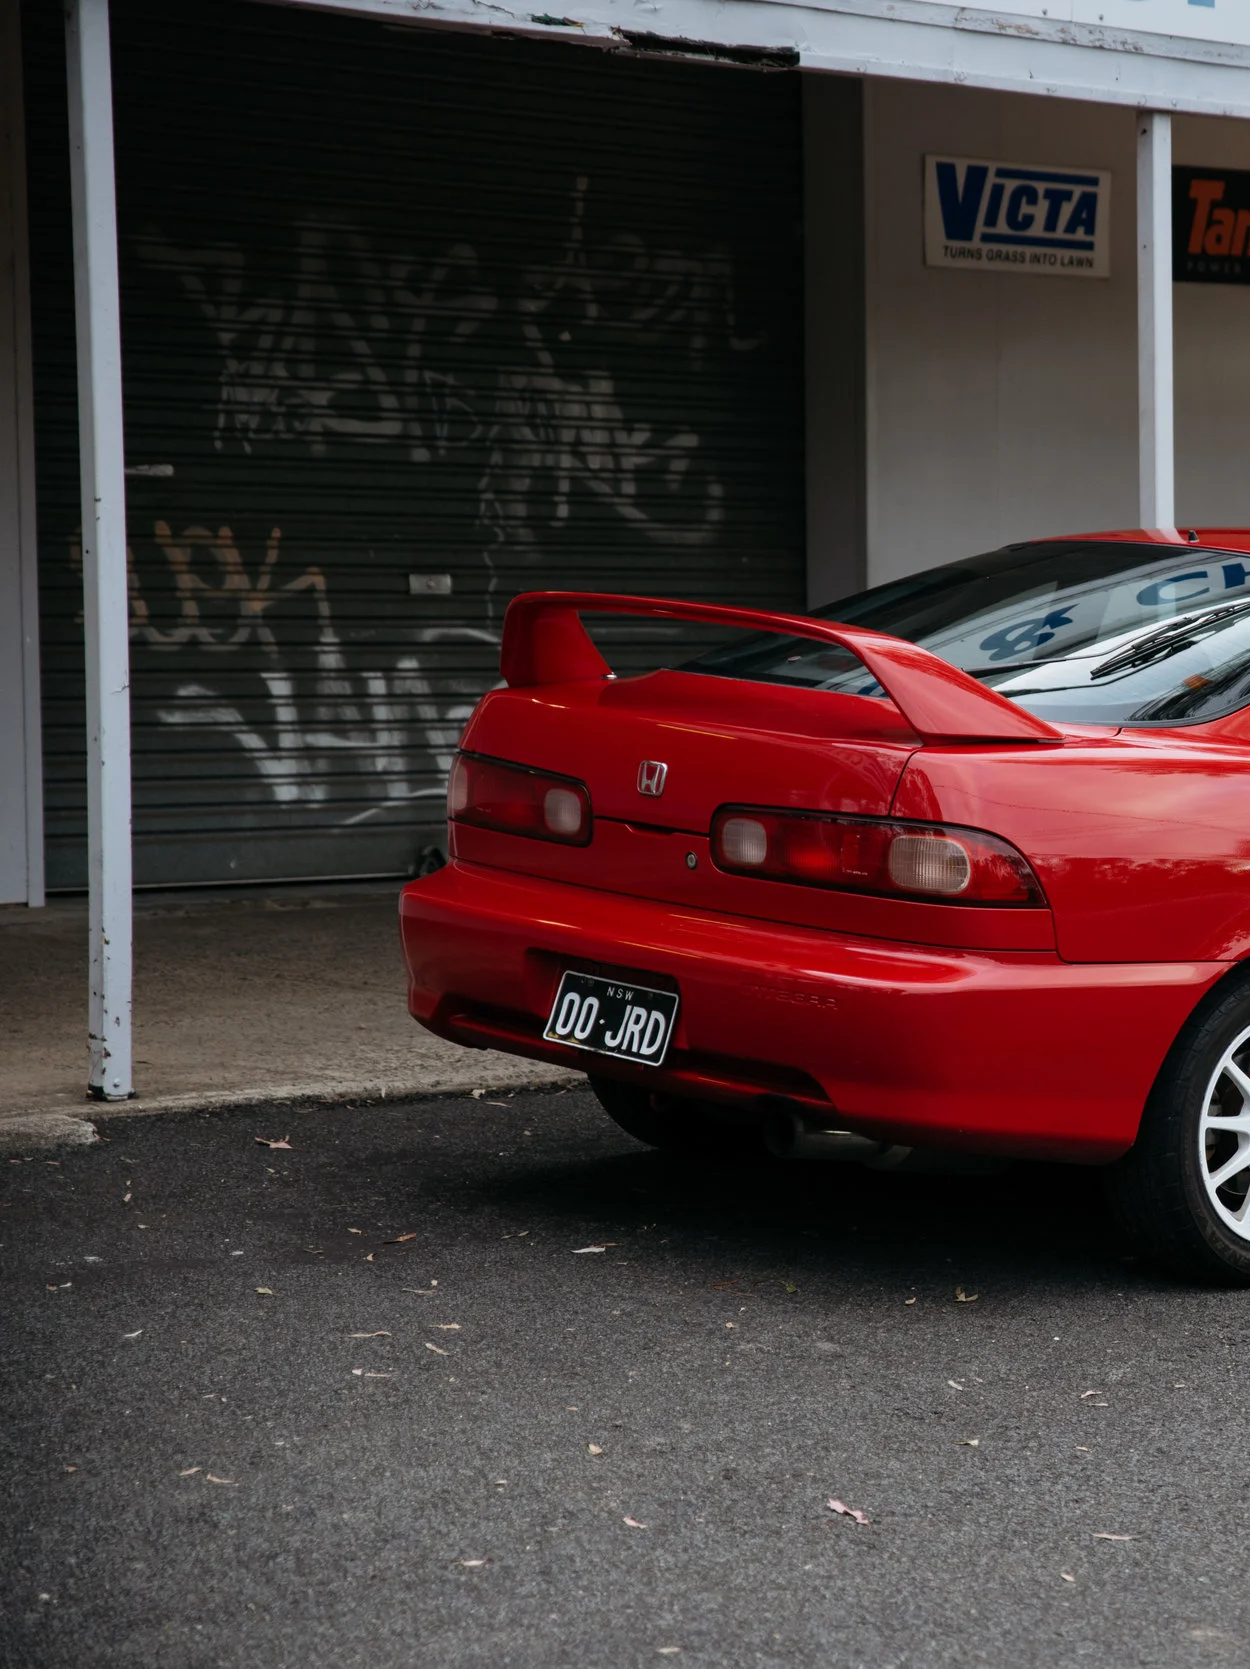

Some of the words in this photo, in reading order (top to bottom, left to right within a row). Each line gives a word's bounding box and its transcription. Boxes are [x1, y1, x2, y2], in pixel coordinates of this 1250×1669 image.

[936, 161, 1098, 242] VICTA
[943, 245, 983, 261] TURNS
[986, 249, 1026, 265] GRASS
[1029, 252, 1057, 266] INTO
[1060, 255, 1094, 269] LAWN
[1186, 260, 1242, 275] POWER
[606, 986, 634, 1001] NSW
